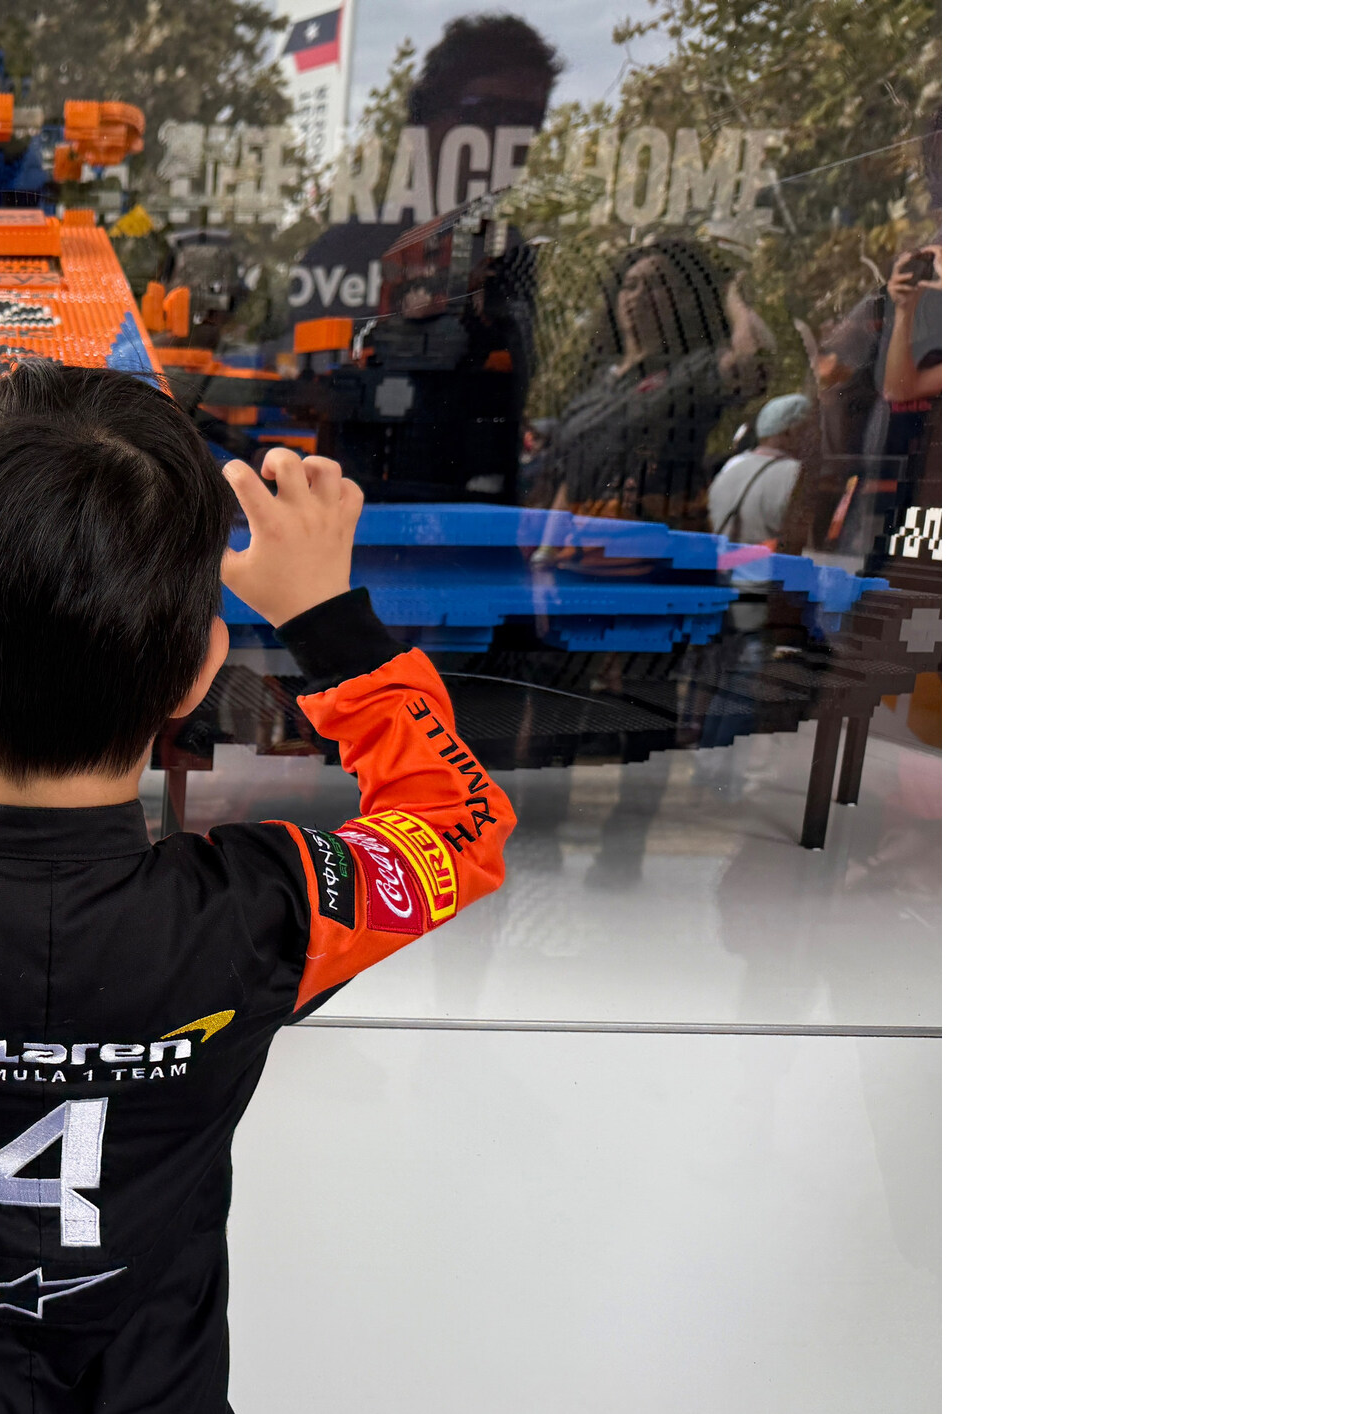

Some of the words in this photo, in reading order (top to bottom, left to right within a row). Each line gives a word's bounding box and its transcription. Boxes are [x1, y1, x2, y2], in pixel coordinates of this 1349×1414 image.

[406, 697, 489, 794] MILLE
[83, 1069, 94, 1082] 1
[114, 1062, 188, 1081] TEAM
